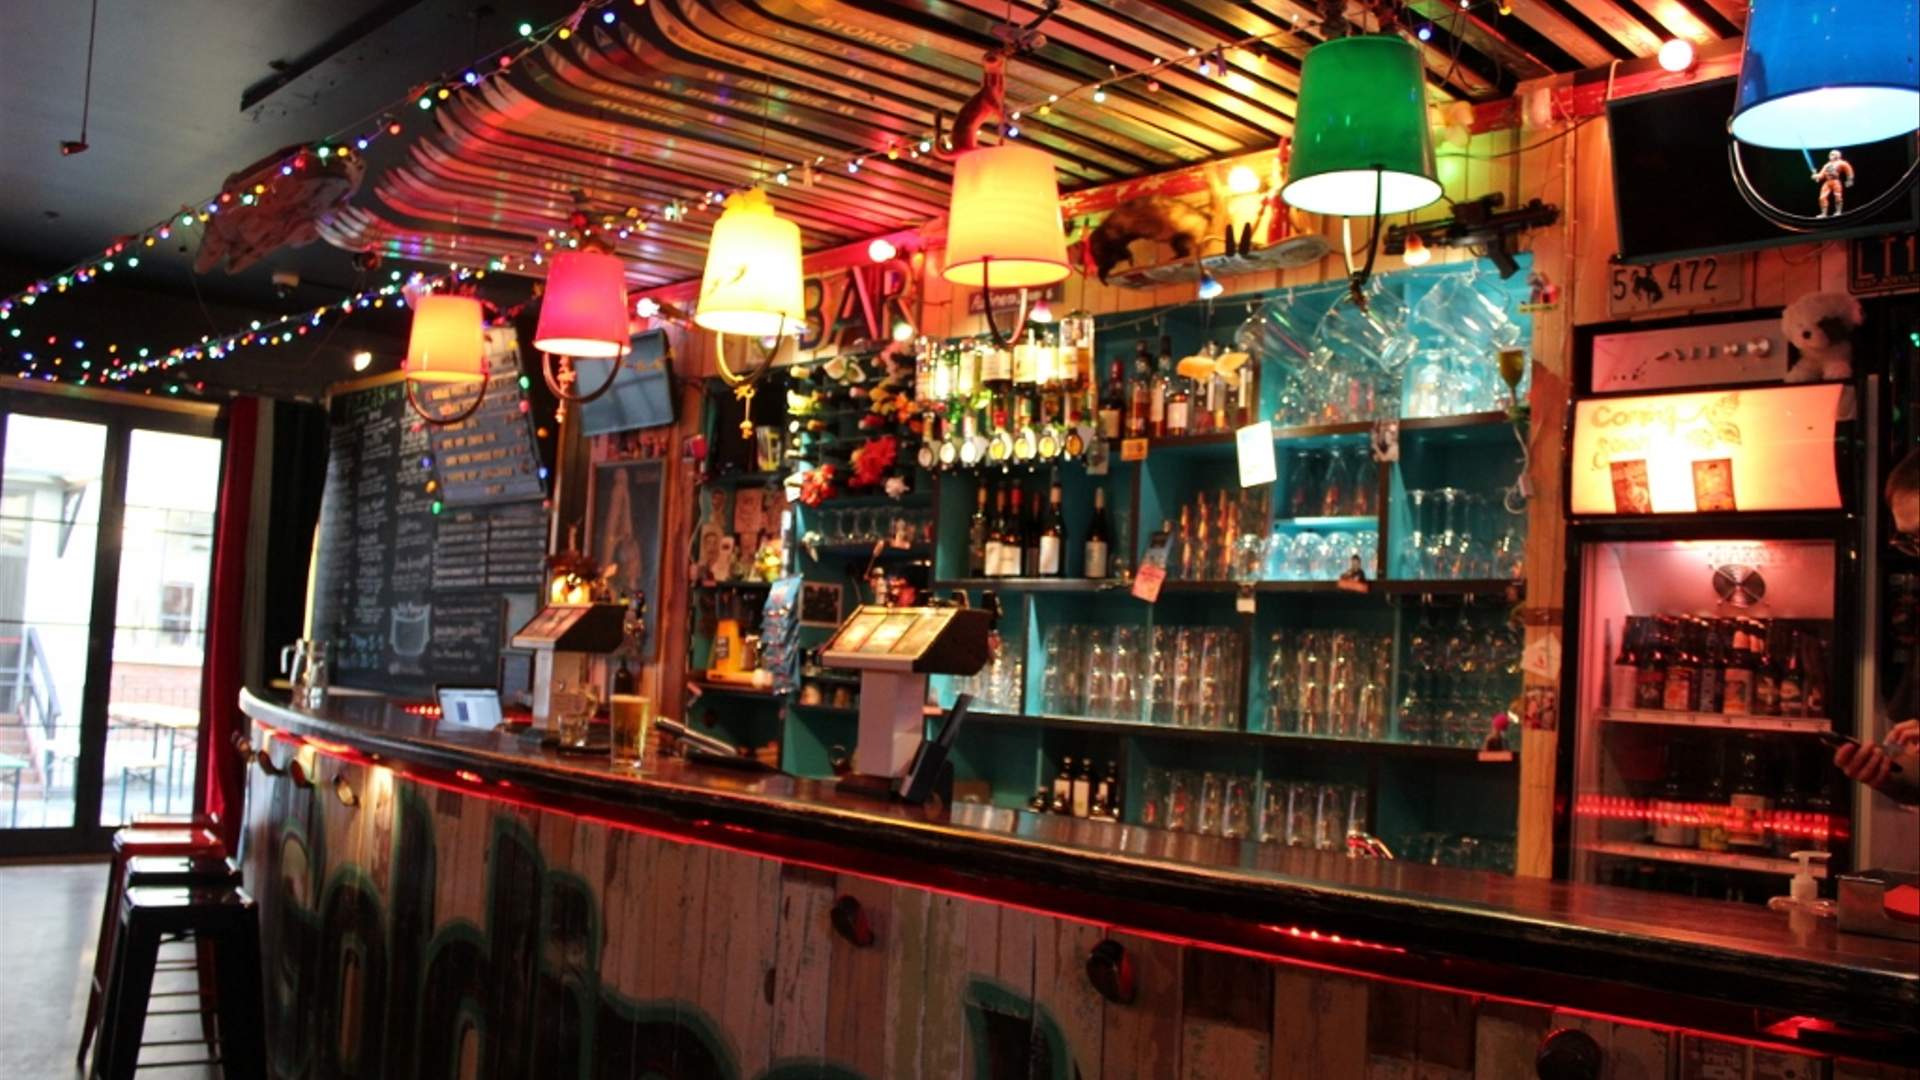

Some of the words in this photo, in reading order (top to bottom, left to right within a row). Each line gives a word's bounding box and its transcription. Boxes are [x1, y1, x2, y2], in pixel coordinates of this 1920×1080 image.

[814, 16, 912, 53] ATOMIC
[1612, 268, 1628, 301] 5
[1667, 257, 1719, 296] 472
[798, 260, 920, 351] BAR
